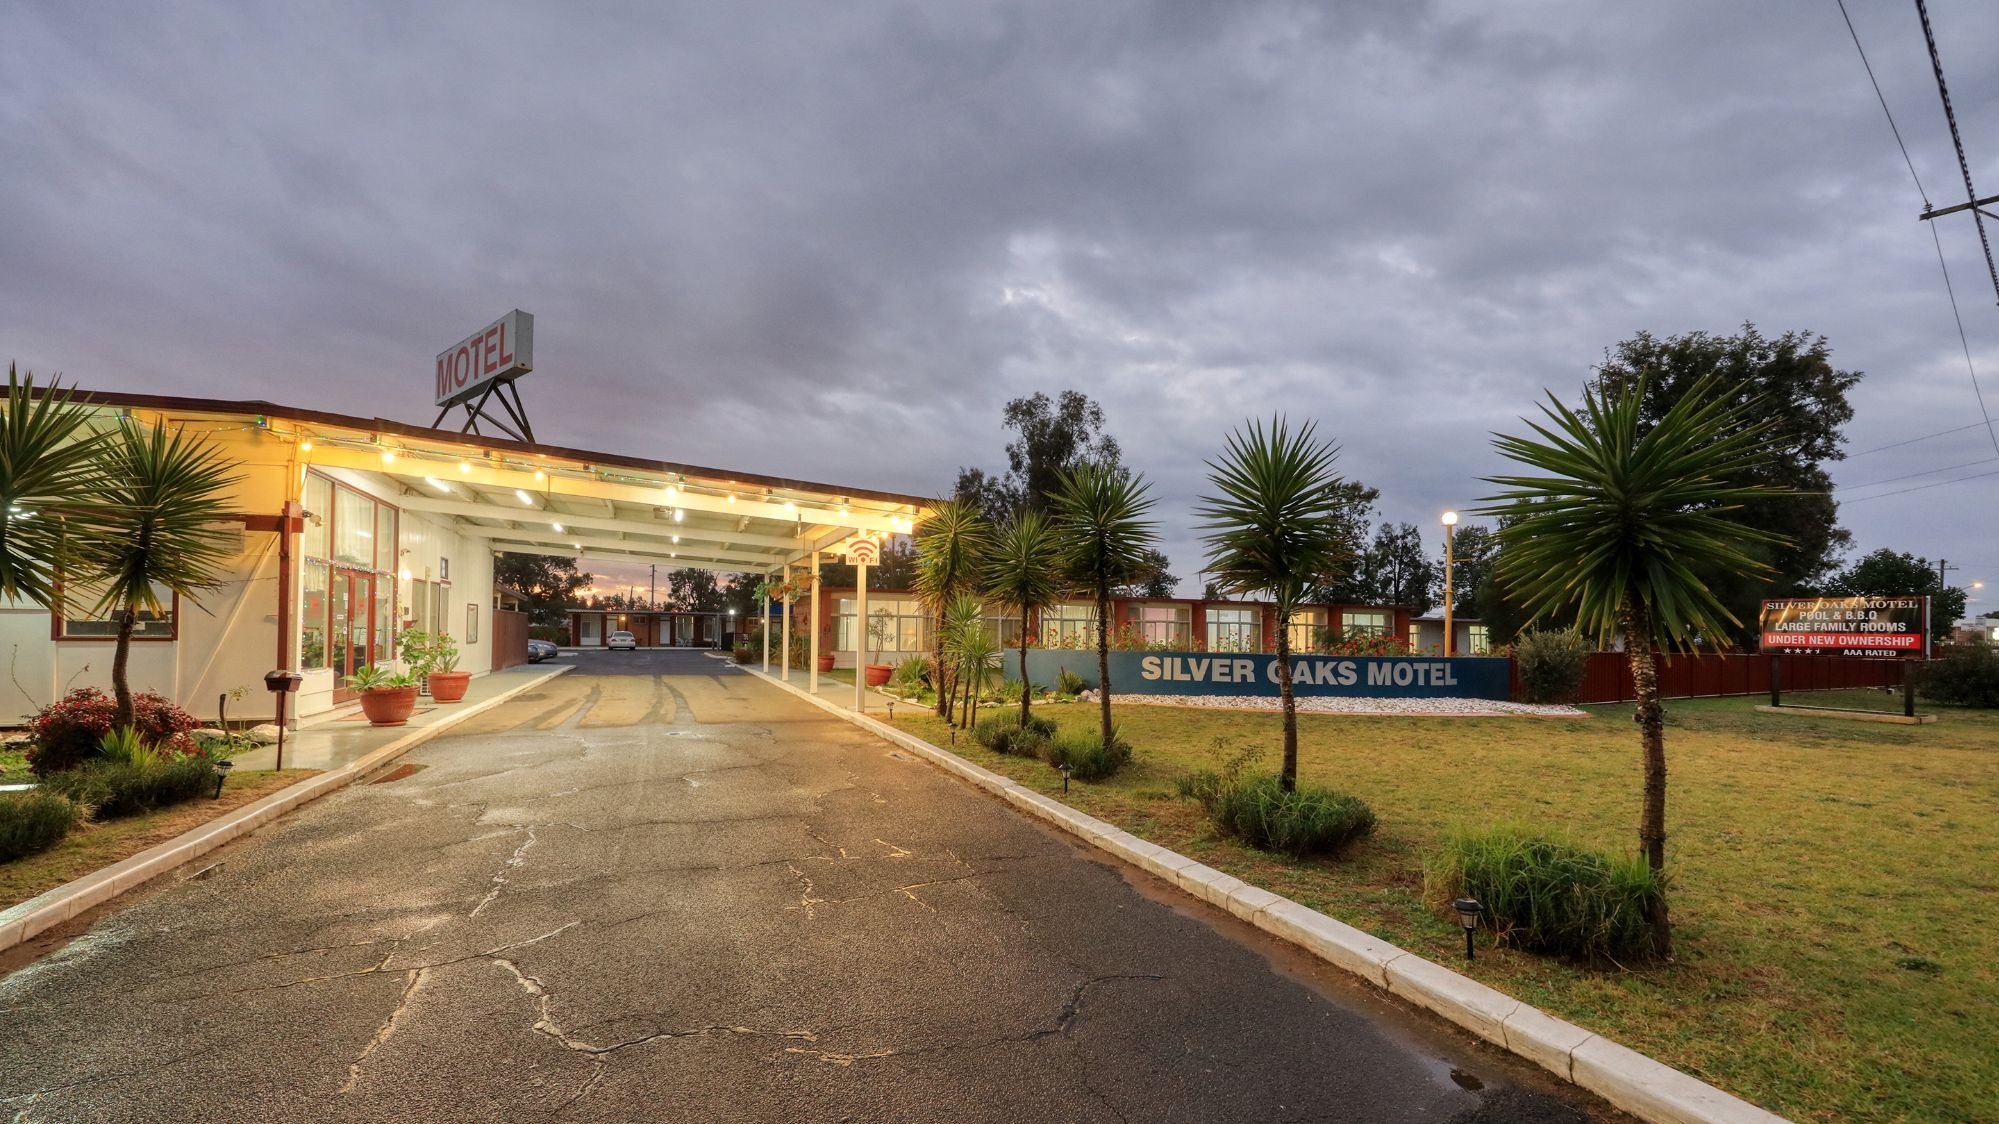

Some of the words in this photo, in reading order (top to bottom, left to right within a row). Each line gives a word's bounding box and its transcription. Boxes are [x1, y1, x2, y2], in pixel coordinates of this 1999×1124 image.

[436, 322, 513, 399] MOTEL
[1863, 600, 1919, 609] MOTEL
[1799, 611, 1829, 620] POOL
[1833, 611, 1842, 620] &
[1845, 610, 1878, 620] B.B.Q
[1775, 622, 1811, 631] LARGE
[1814, 622, 1857, 632] FAMILY
[1860, 622, 1907, 632] ROOMS
[1768, 635, 1806, 644] UNDER
[1809, 636, 1836, 645] NEW
[1838, 635, 1914, 646] OWNERSHIP
[1865, 649, 1897, 657] RATED
[1141, 656, 1256, 683] SILVER
[1367, 662, 1458, 687] MOTEL
